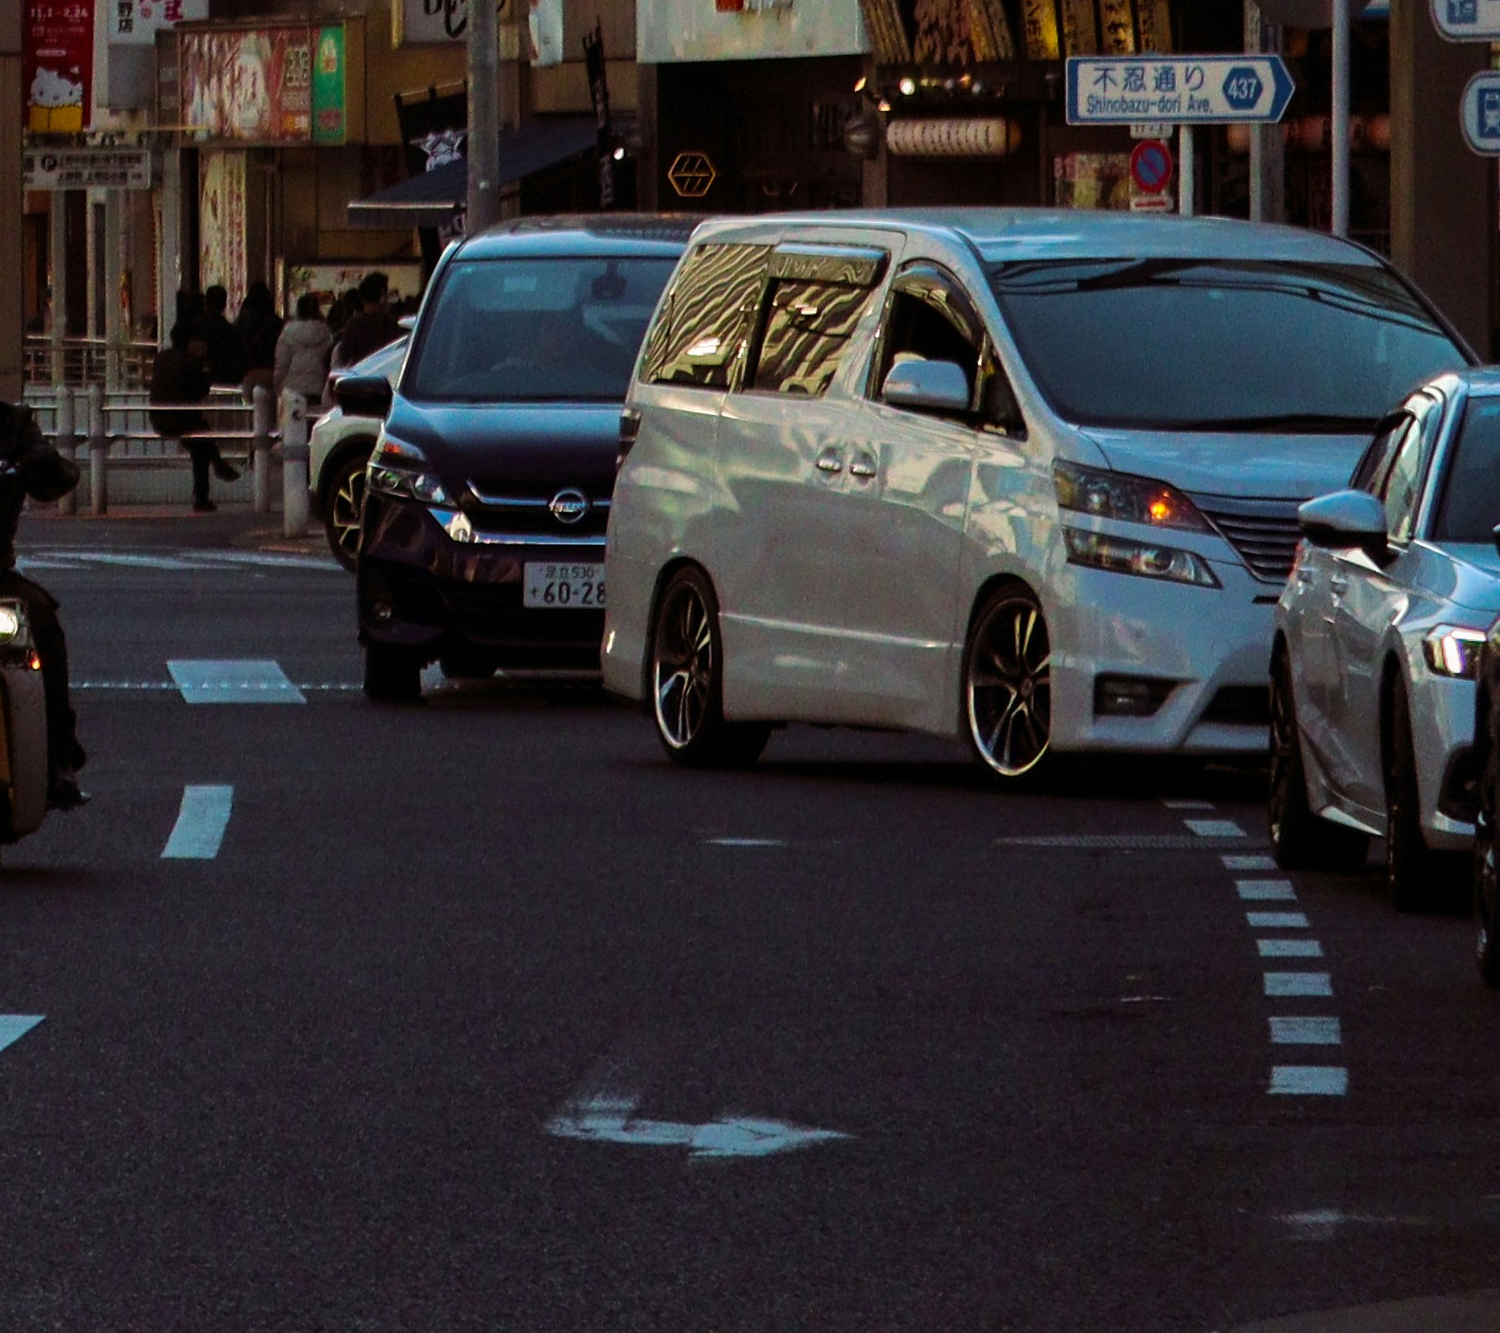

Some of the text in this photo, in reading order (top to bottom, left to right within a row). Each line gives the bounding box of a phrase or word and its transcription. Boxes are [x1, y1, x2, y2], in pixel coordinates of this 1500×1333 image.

[1092, 66, 1166, 94] 不忍通り
[1227, 78, 1258, 100] 437
[1086, 94, 1215, 116] Shinobazu-dori Ave.
